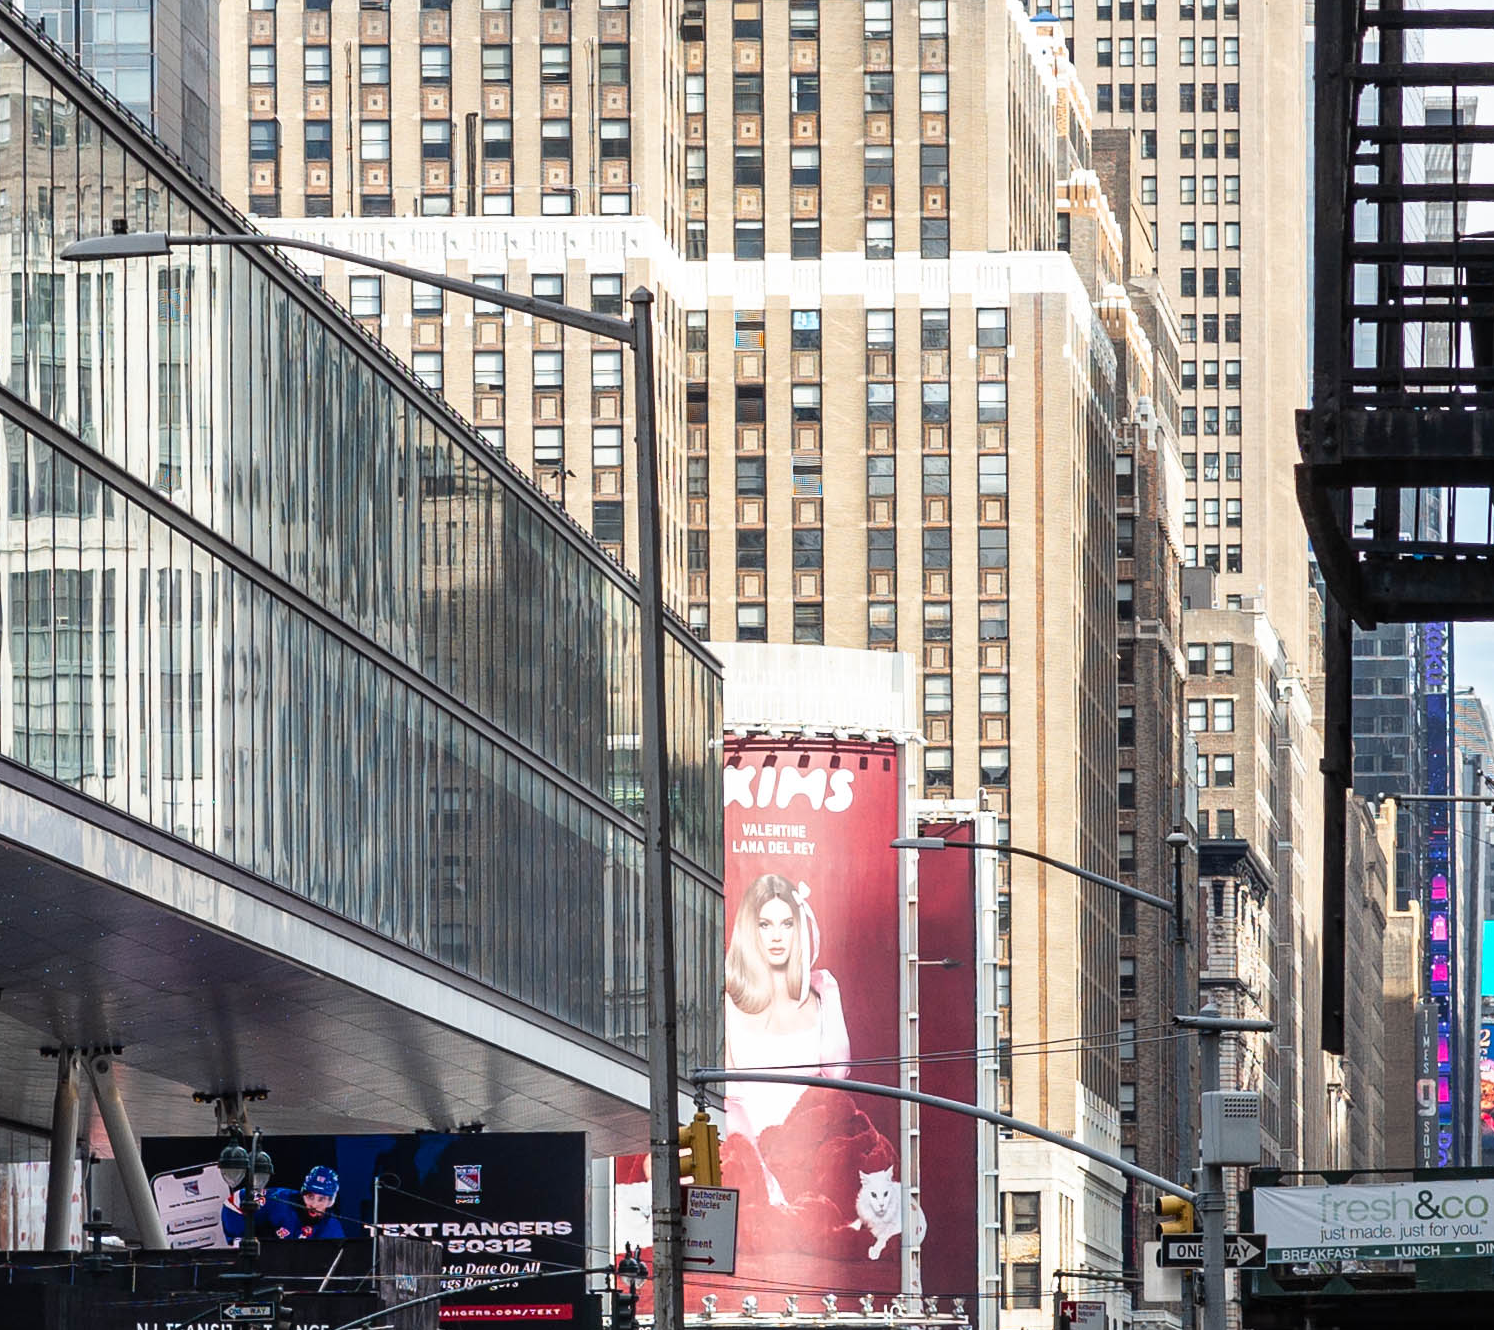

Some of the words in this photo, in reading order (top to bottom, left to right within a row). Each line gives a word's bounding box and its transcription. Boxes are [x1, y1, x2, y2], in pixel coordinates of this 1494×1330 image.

[724, 765, 854, 813] KIMS
[742, 823, 807, 839] VALENTINE
[732, 840, 765, 855] LANA
[769, 841, 789, 855] DEL
[793, 841, 815, 855] REY
[690, 1190, 732, 1202] Authorized
[689, 1199, 721, 1211] Vehicles
[1319, 1190, 1489, 1224] fresh&co
[689, 1208, 706, 1219] Only
[364, 1223, 438, 1237] TEXT
[442, 1222, 572, 1237] RANGERS
[1321, 1223, 1346, 1242] just
[1349, 1223, 1395, 1239] made.
[1399, 1222, 1425, 1240] just
[1429, 1221, 1450, 1238] for
[1452, 1223, 1483, 1241] you.
[448, 1239, 532, 1253] 50312
[1282, 1247, 1358, 1261] BREAKFAST
[1394, 1244, 1440, 1257] LUNCH
[449, 1263, 462, 1275] to
[465, 1263, 498, 1275] Date
[500, 1262, 519, 1274] On
[523, 1262, 540, 1274] All
